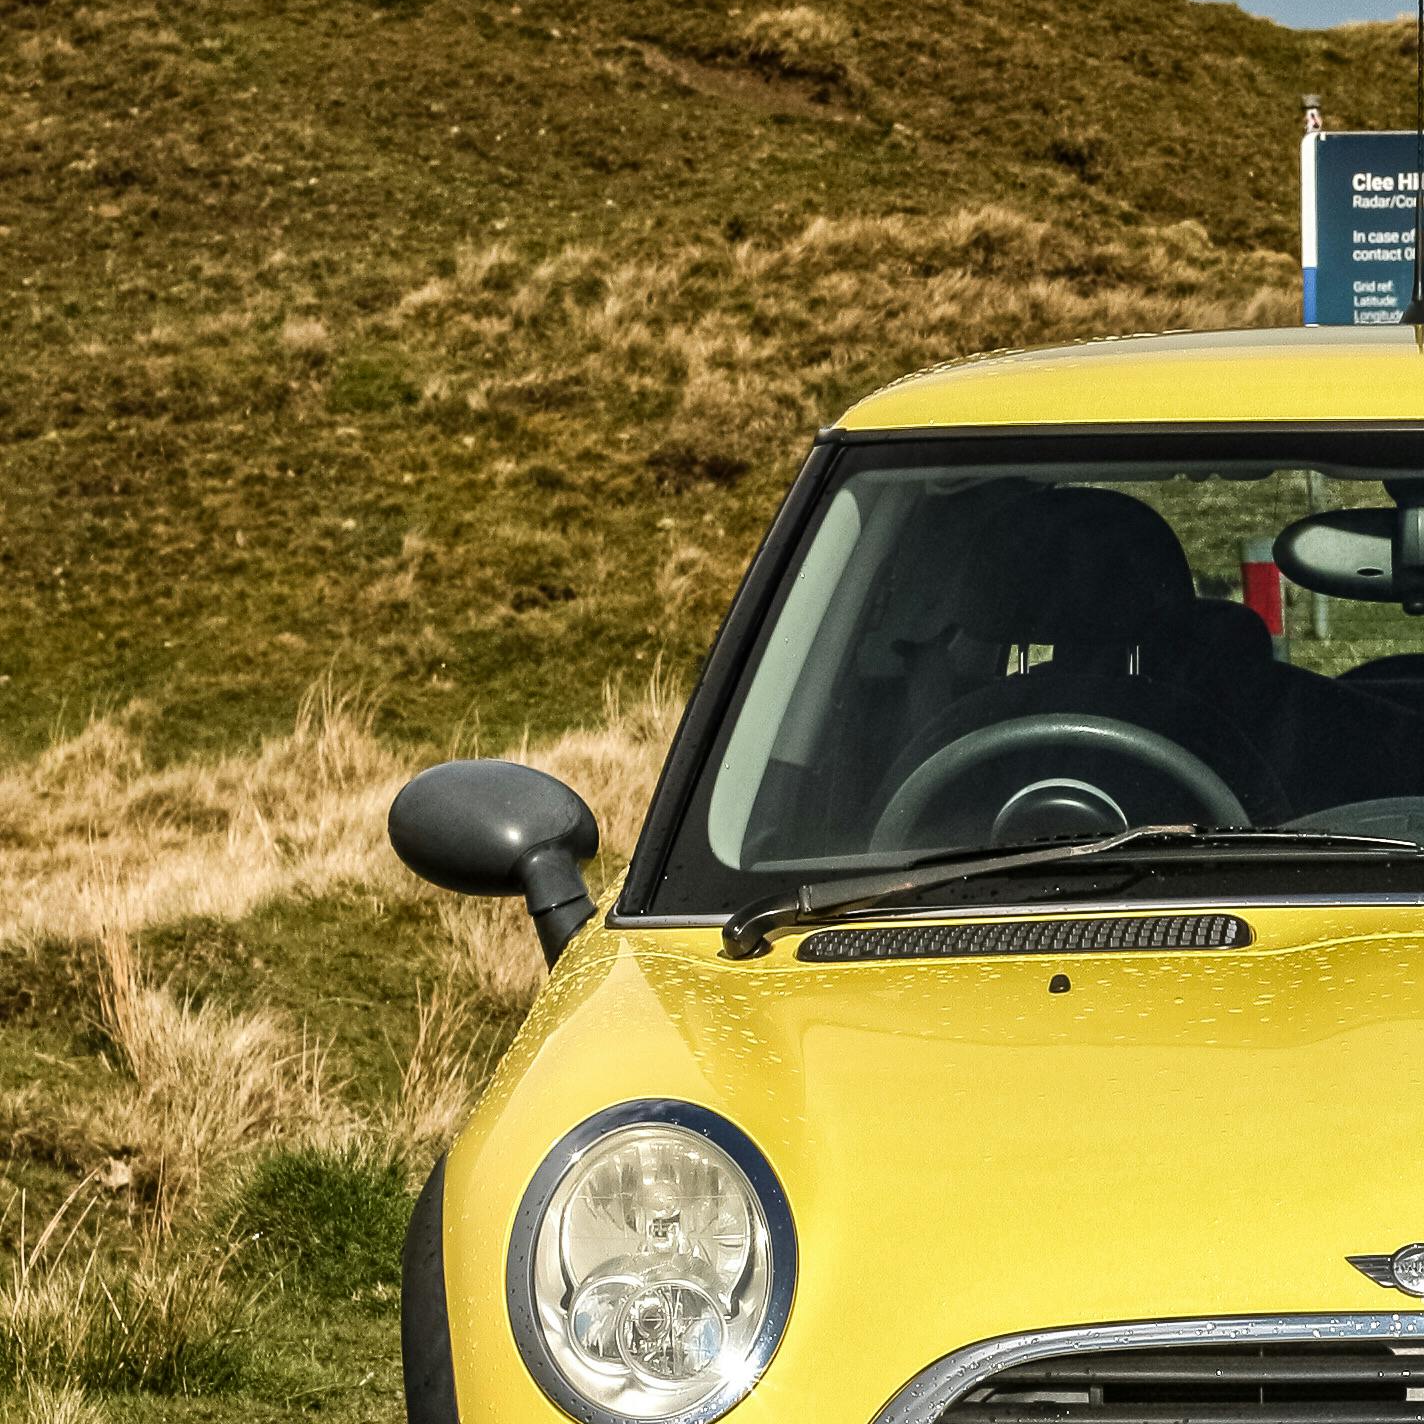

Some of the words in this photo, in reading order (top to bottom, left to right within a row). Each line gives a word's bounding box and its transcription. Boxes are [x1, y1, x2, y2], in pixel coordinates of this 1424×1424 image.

[1353, 173, 1394, 191] Clee
[1353, 230, 1366, 243] In
[1368, 231, 1398, 244] case
[1353, 247, 1401, 261] contact
[1353, 279, 1376, 293] Grid
